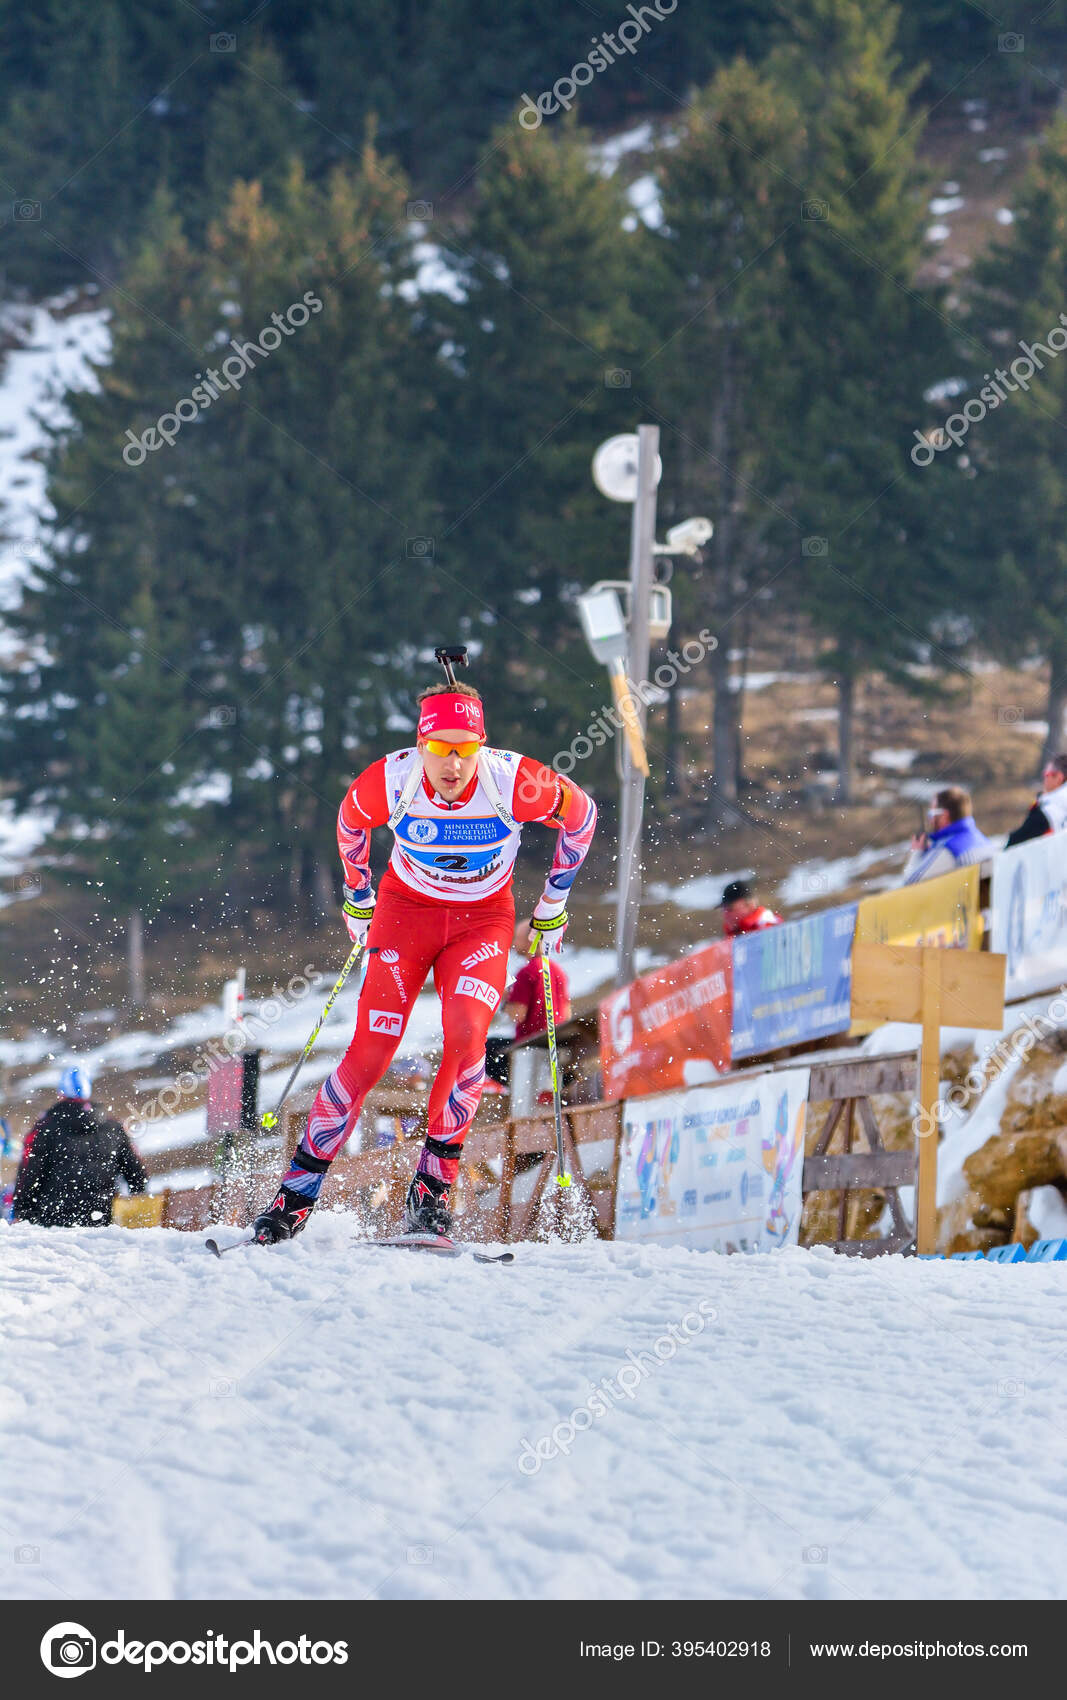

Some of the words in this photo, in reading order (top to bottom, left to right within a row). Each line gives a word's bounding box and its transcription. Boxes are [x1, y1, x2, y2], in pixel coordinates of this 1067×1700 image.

[455, 702, 481, 718] DNB
[495, 802, 513, 823] LARSEN
[433, 854, 471, 871] 2
[461, 940, 504, 970] swix
[388, 964, 408, 1004] Statkraft
[462, 979, 499, 1005] DNB
